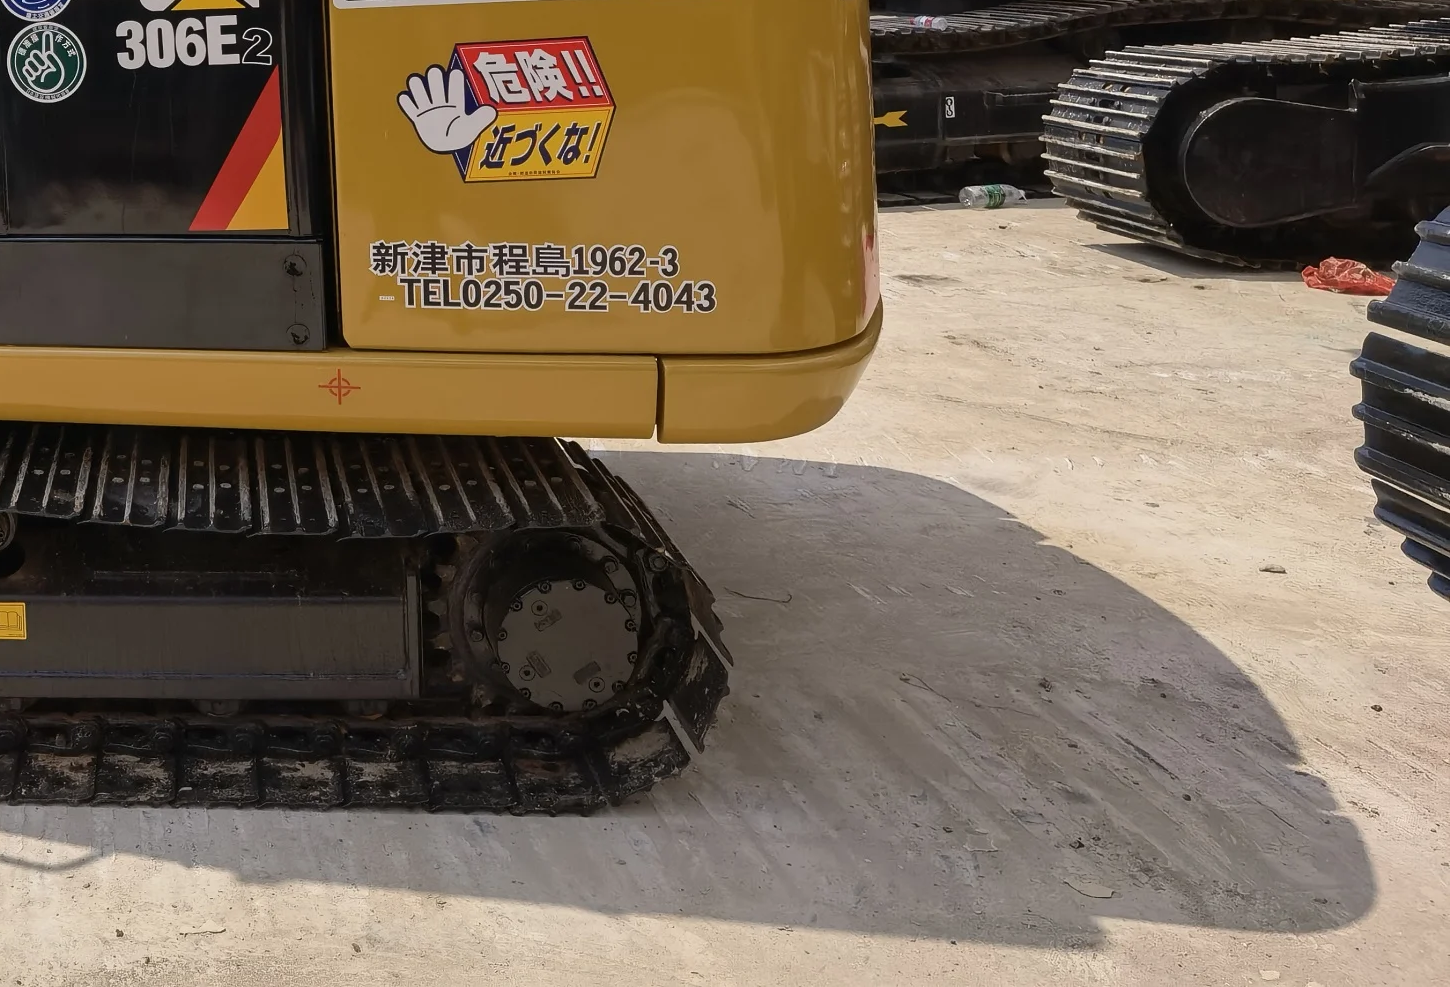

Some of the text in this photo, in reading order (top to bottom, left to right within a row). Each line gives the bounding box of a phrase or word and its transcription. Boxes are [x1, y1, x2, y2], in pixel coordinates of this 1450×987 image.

[115, 15, 273, 70] 306E2
[473, 48, 604, 104] 危険!!
[479, 121, 602, 171] 近づくな!
[370, 240, 680, 278] 新津市程島1962-3
[399, 277, 717, 314] TEL0250-22-4043
